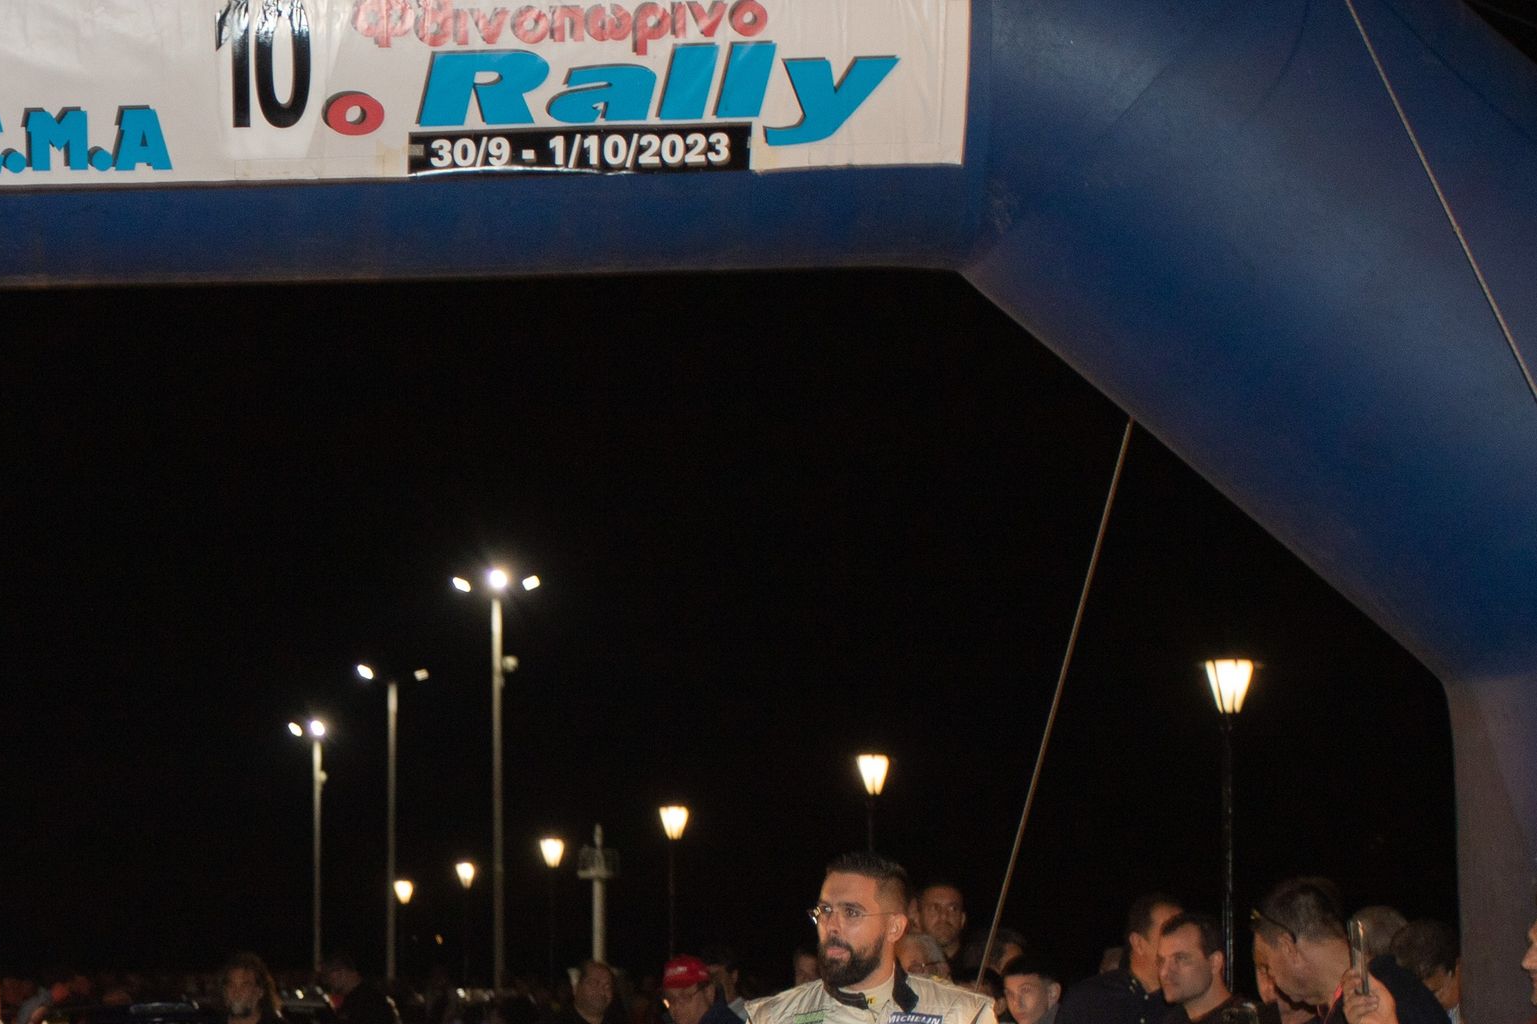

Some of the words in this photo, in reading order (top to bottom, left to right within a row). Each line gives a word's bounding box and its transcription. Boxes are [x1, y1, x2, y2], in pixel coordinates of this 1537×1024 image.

[214, 0, 311, 129] 10
[415, 41, 901, 146] Rally
[429, 137, 509, 168] 30/9
[548, 132, 731, 168] 1/10/2023
